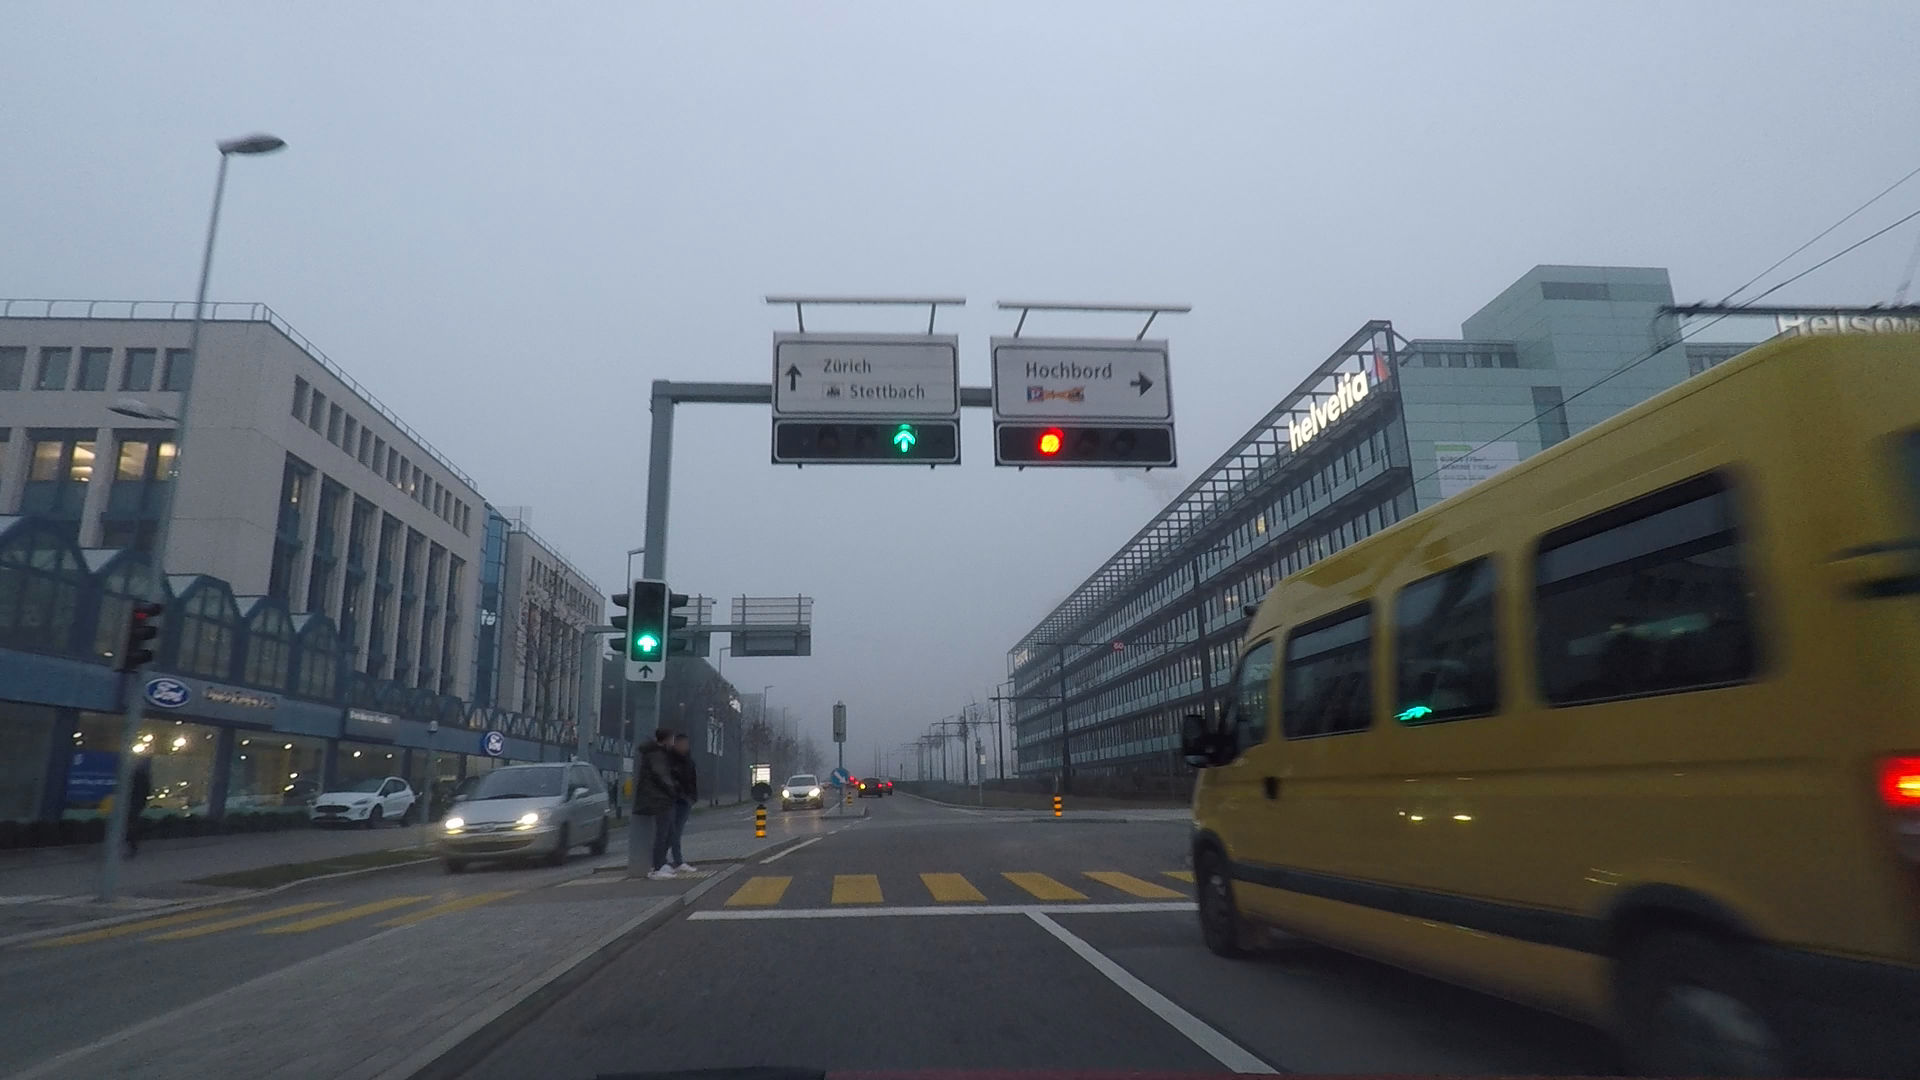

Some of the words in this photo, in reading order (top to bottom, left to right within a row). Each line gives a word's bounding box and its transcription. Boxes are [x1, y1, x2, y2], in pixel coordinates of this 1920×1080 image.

[823, 358, 872, 374] Zürich
[1026, 361, 1113, 380] Hochbord
[849, 384, 926, 400] Stettbach
[1288, 369, 1370, 453] helvetia
